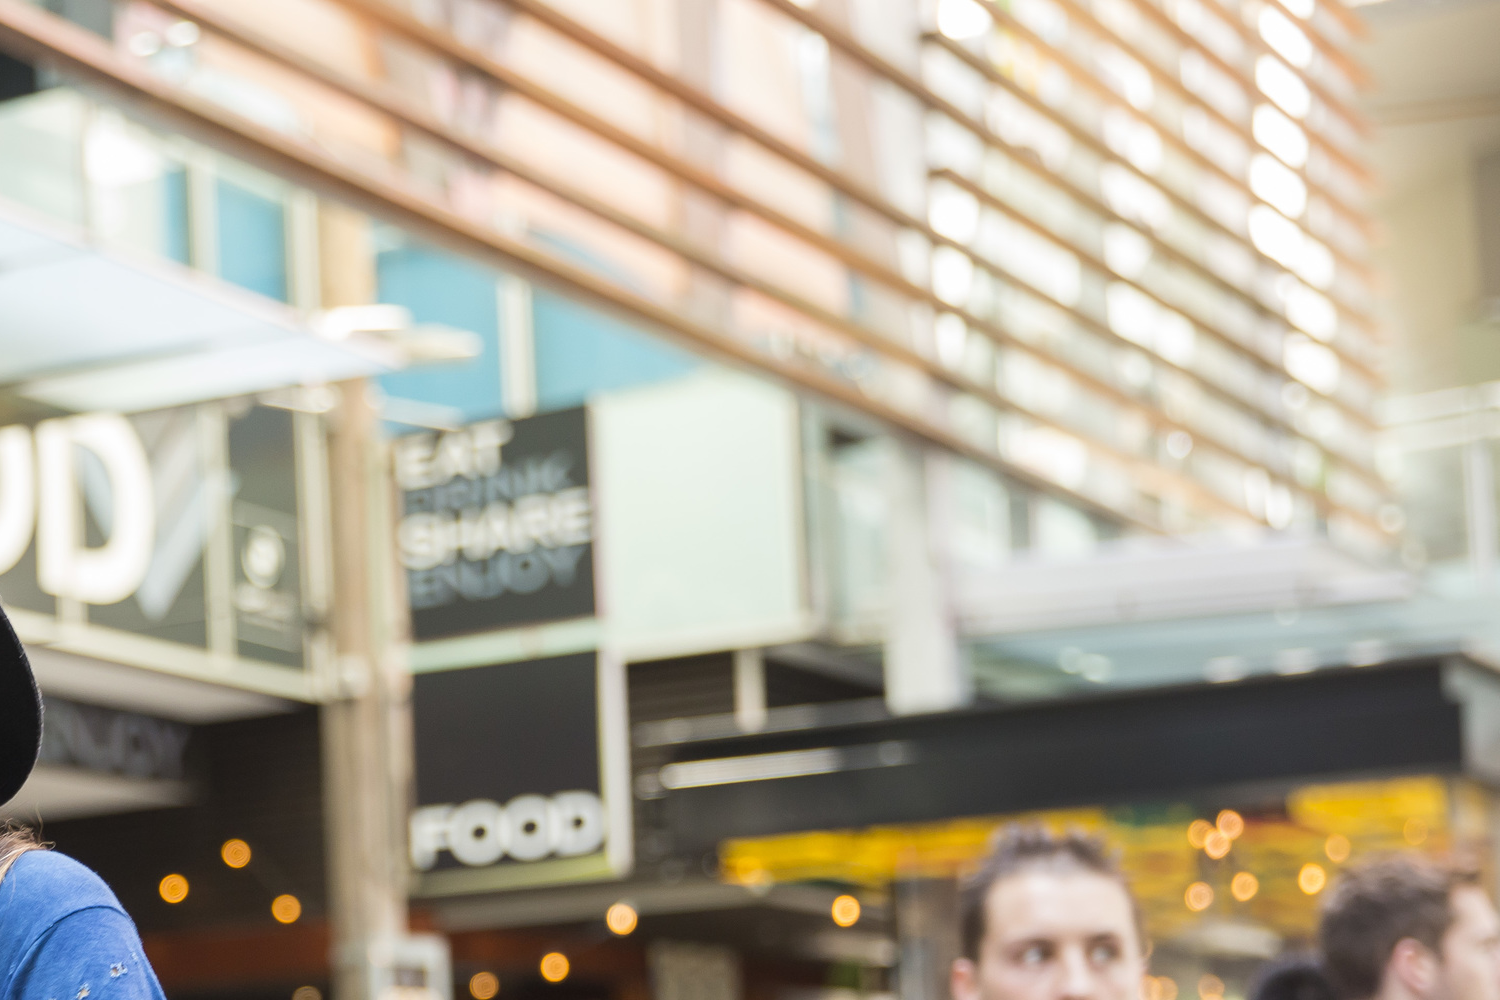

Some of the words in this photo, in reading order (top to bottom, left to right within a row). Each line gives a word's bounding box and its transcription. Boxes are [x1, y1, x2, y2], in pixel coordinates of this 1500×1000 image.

[395, 417, 514, 491] EAT
[398, 486, 592, 571] SHARE
[405, 546, 587, 611] ENJOY
[408, 788, 605, 872] FOOD
